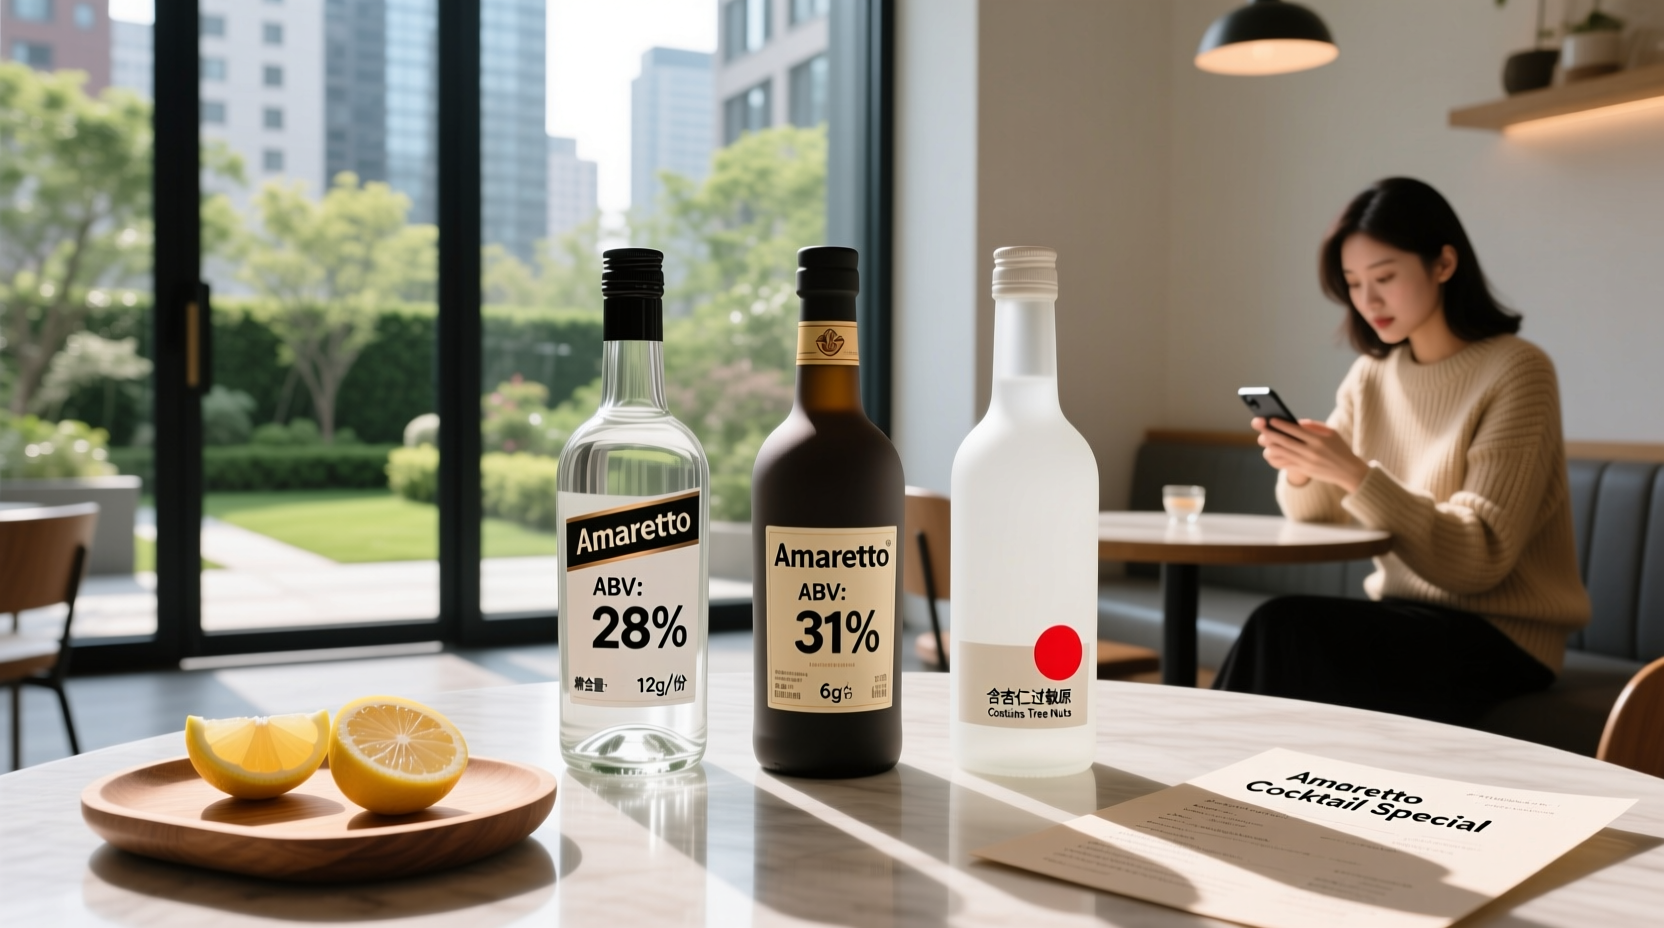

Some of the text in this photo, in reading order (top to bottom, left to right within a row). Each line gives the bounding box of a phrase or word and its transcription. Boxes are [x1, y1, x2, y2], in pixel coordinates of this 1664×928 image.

[576, 511, 691, 555] Amaretto
[774, 542, 890, 568] Amaretto
[592, 576, 643, 597] ABV:
[798, 583, 846, 601] ABV:
[592, 604, 688, 649] 28%
[794, 609, 880, 654] 31%
[1027, 707, 1048, 719] Tree
[1050, 708, 1072, 718] Nuts
[1285, 771, 1423, 805] Amaretto
[1246, 780, 1369, 811] Cocktail
[1370, 803, 1492, 833] Special
